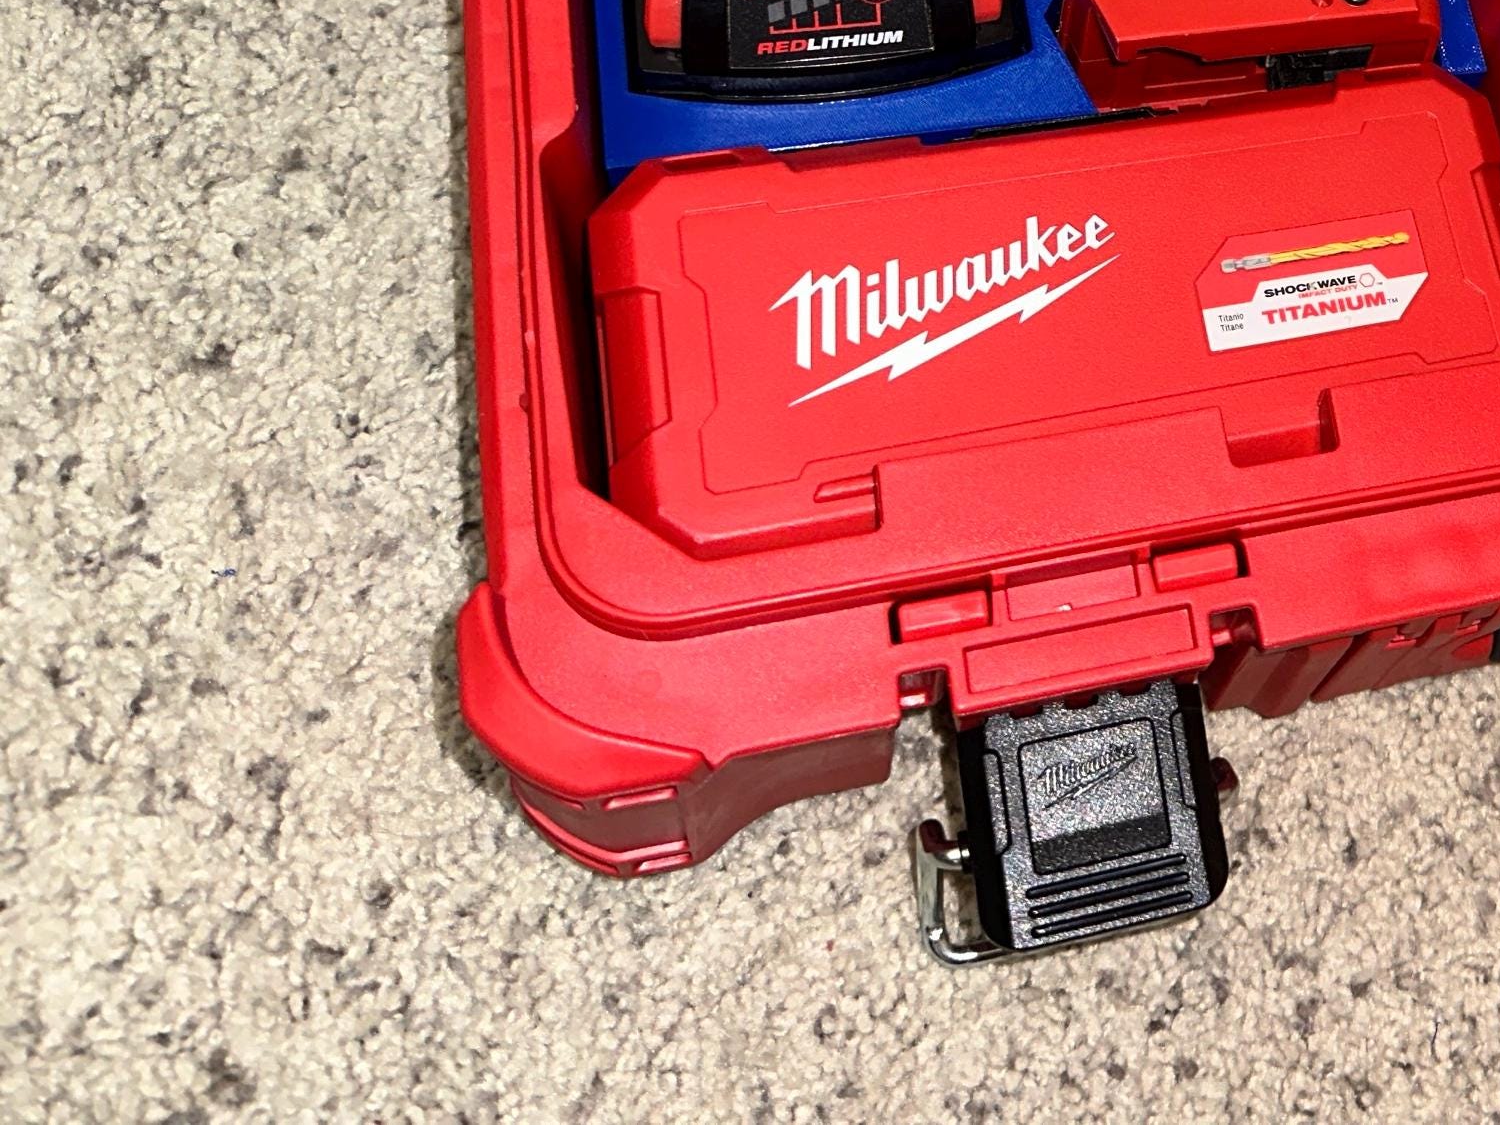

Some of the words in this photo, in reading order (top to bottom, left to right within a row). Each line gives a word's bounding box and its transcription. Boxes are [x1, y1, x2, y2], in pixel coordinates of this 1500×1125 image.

[757, 30, 904, 55] REDLITHIUM
[769, 213, 1115, 370] Milwaukee
[1335, 284, 1358, 294] DUTY
[1262, 291, 1387, 325] TITANIUM
[1218, 312, 1243, 323] Titanio
[1220, 322, 1244, 332] Titane
